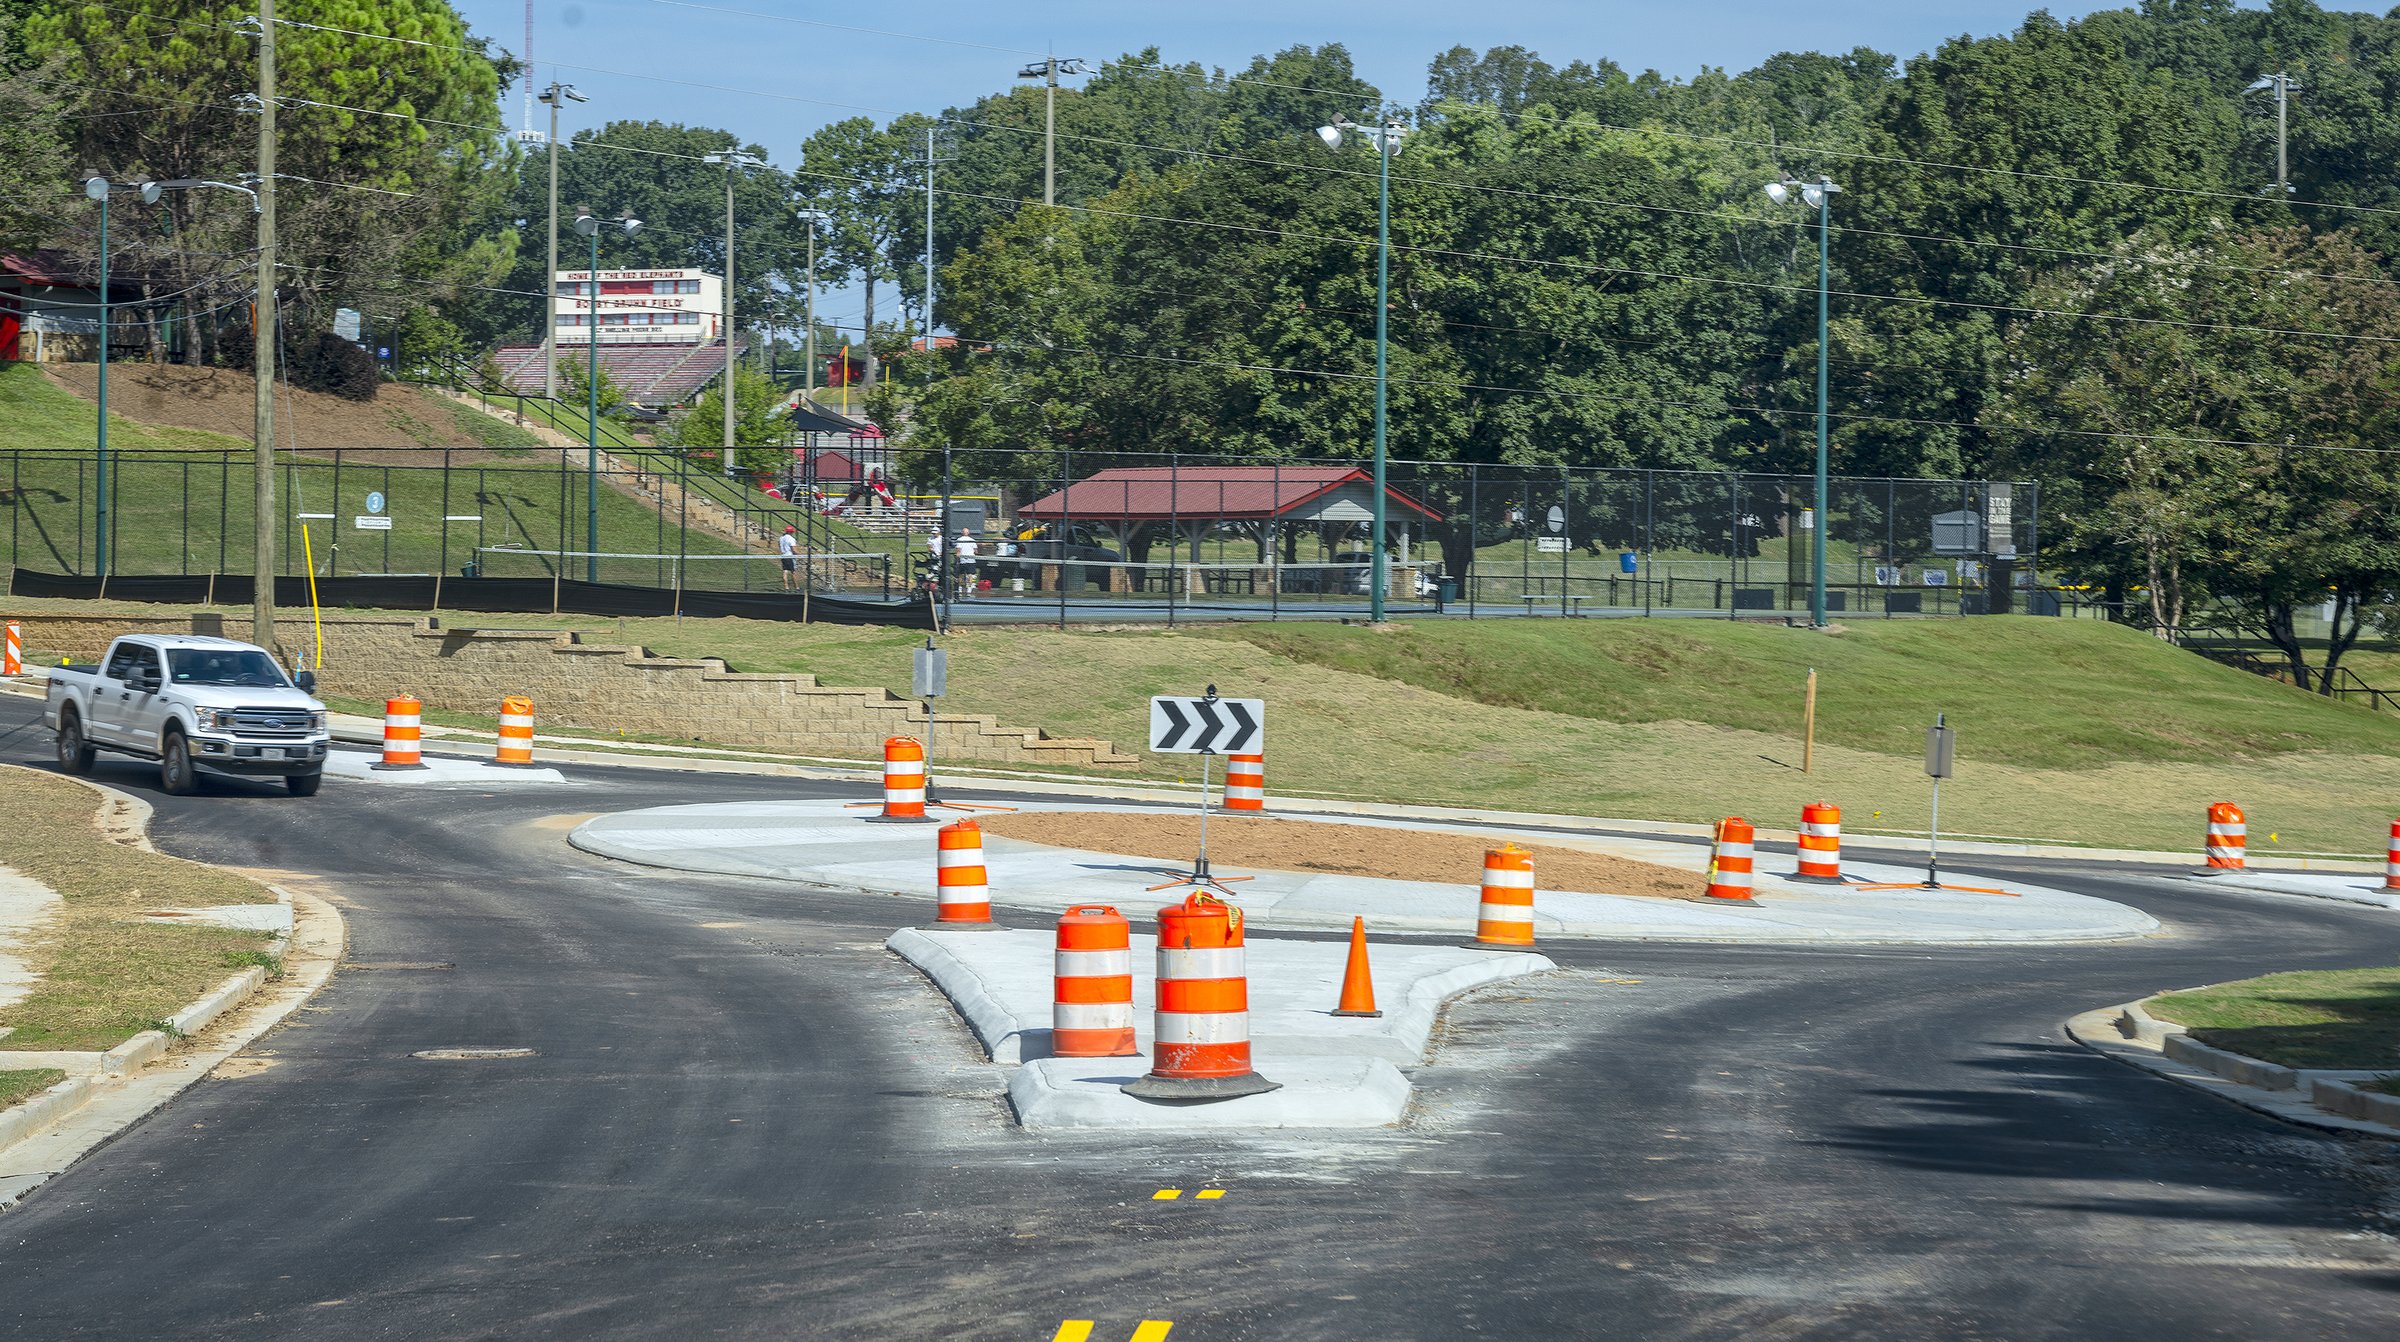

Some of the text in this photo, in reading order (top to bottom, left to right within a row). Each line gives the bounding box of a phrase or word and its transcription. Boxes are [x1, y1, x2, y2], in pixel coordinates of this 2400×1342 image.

[576, 300, 608, 308] BOBY
[652, 298, 682, 308] FIELD
[1988, 497, 2012, 507] STAY
[1988, 514, 2011, 524] GAME
